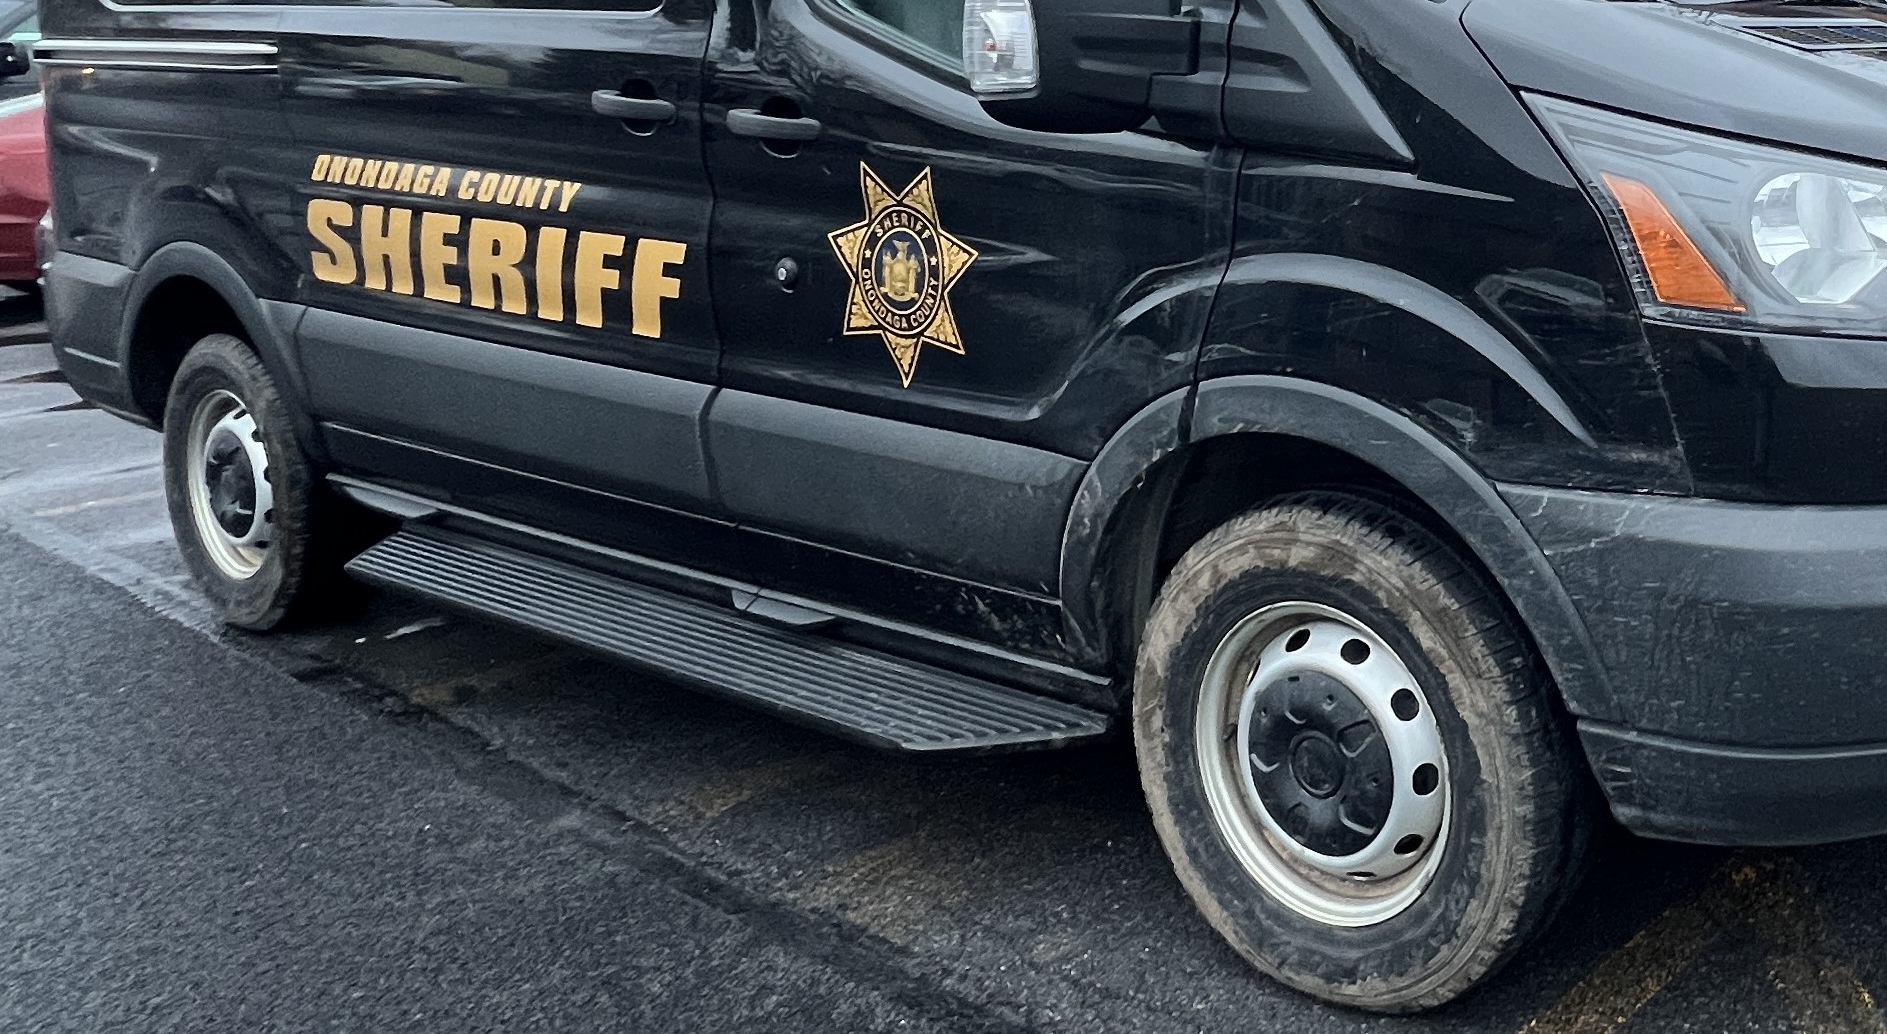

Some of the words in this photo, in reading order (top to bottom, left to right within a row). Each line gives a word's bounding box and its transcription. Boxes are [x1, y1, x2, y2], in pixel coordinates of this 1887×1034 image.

[311, 154, 452, 197] ONONDAGA
[457, 170, 582, 212] COUNTY
[874, 213, 931, 240] SHERIFF
[306, 198, 688, 339] SHERIFF
[862, 268, 908, 330] ONONDAGA
[910, 276, 940, 327] COUNTY
